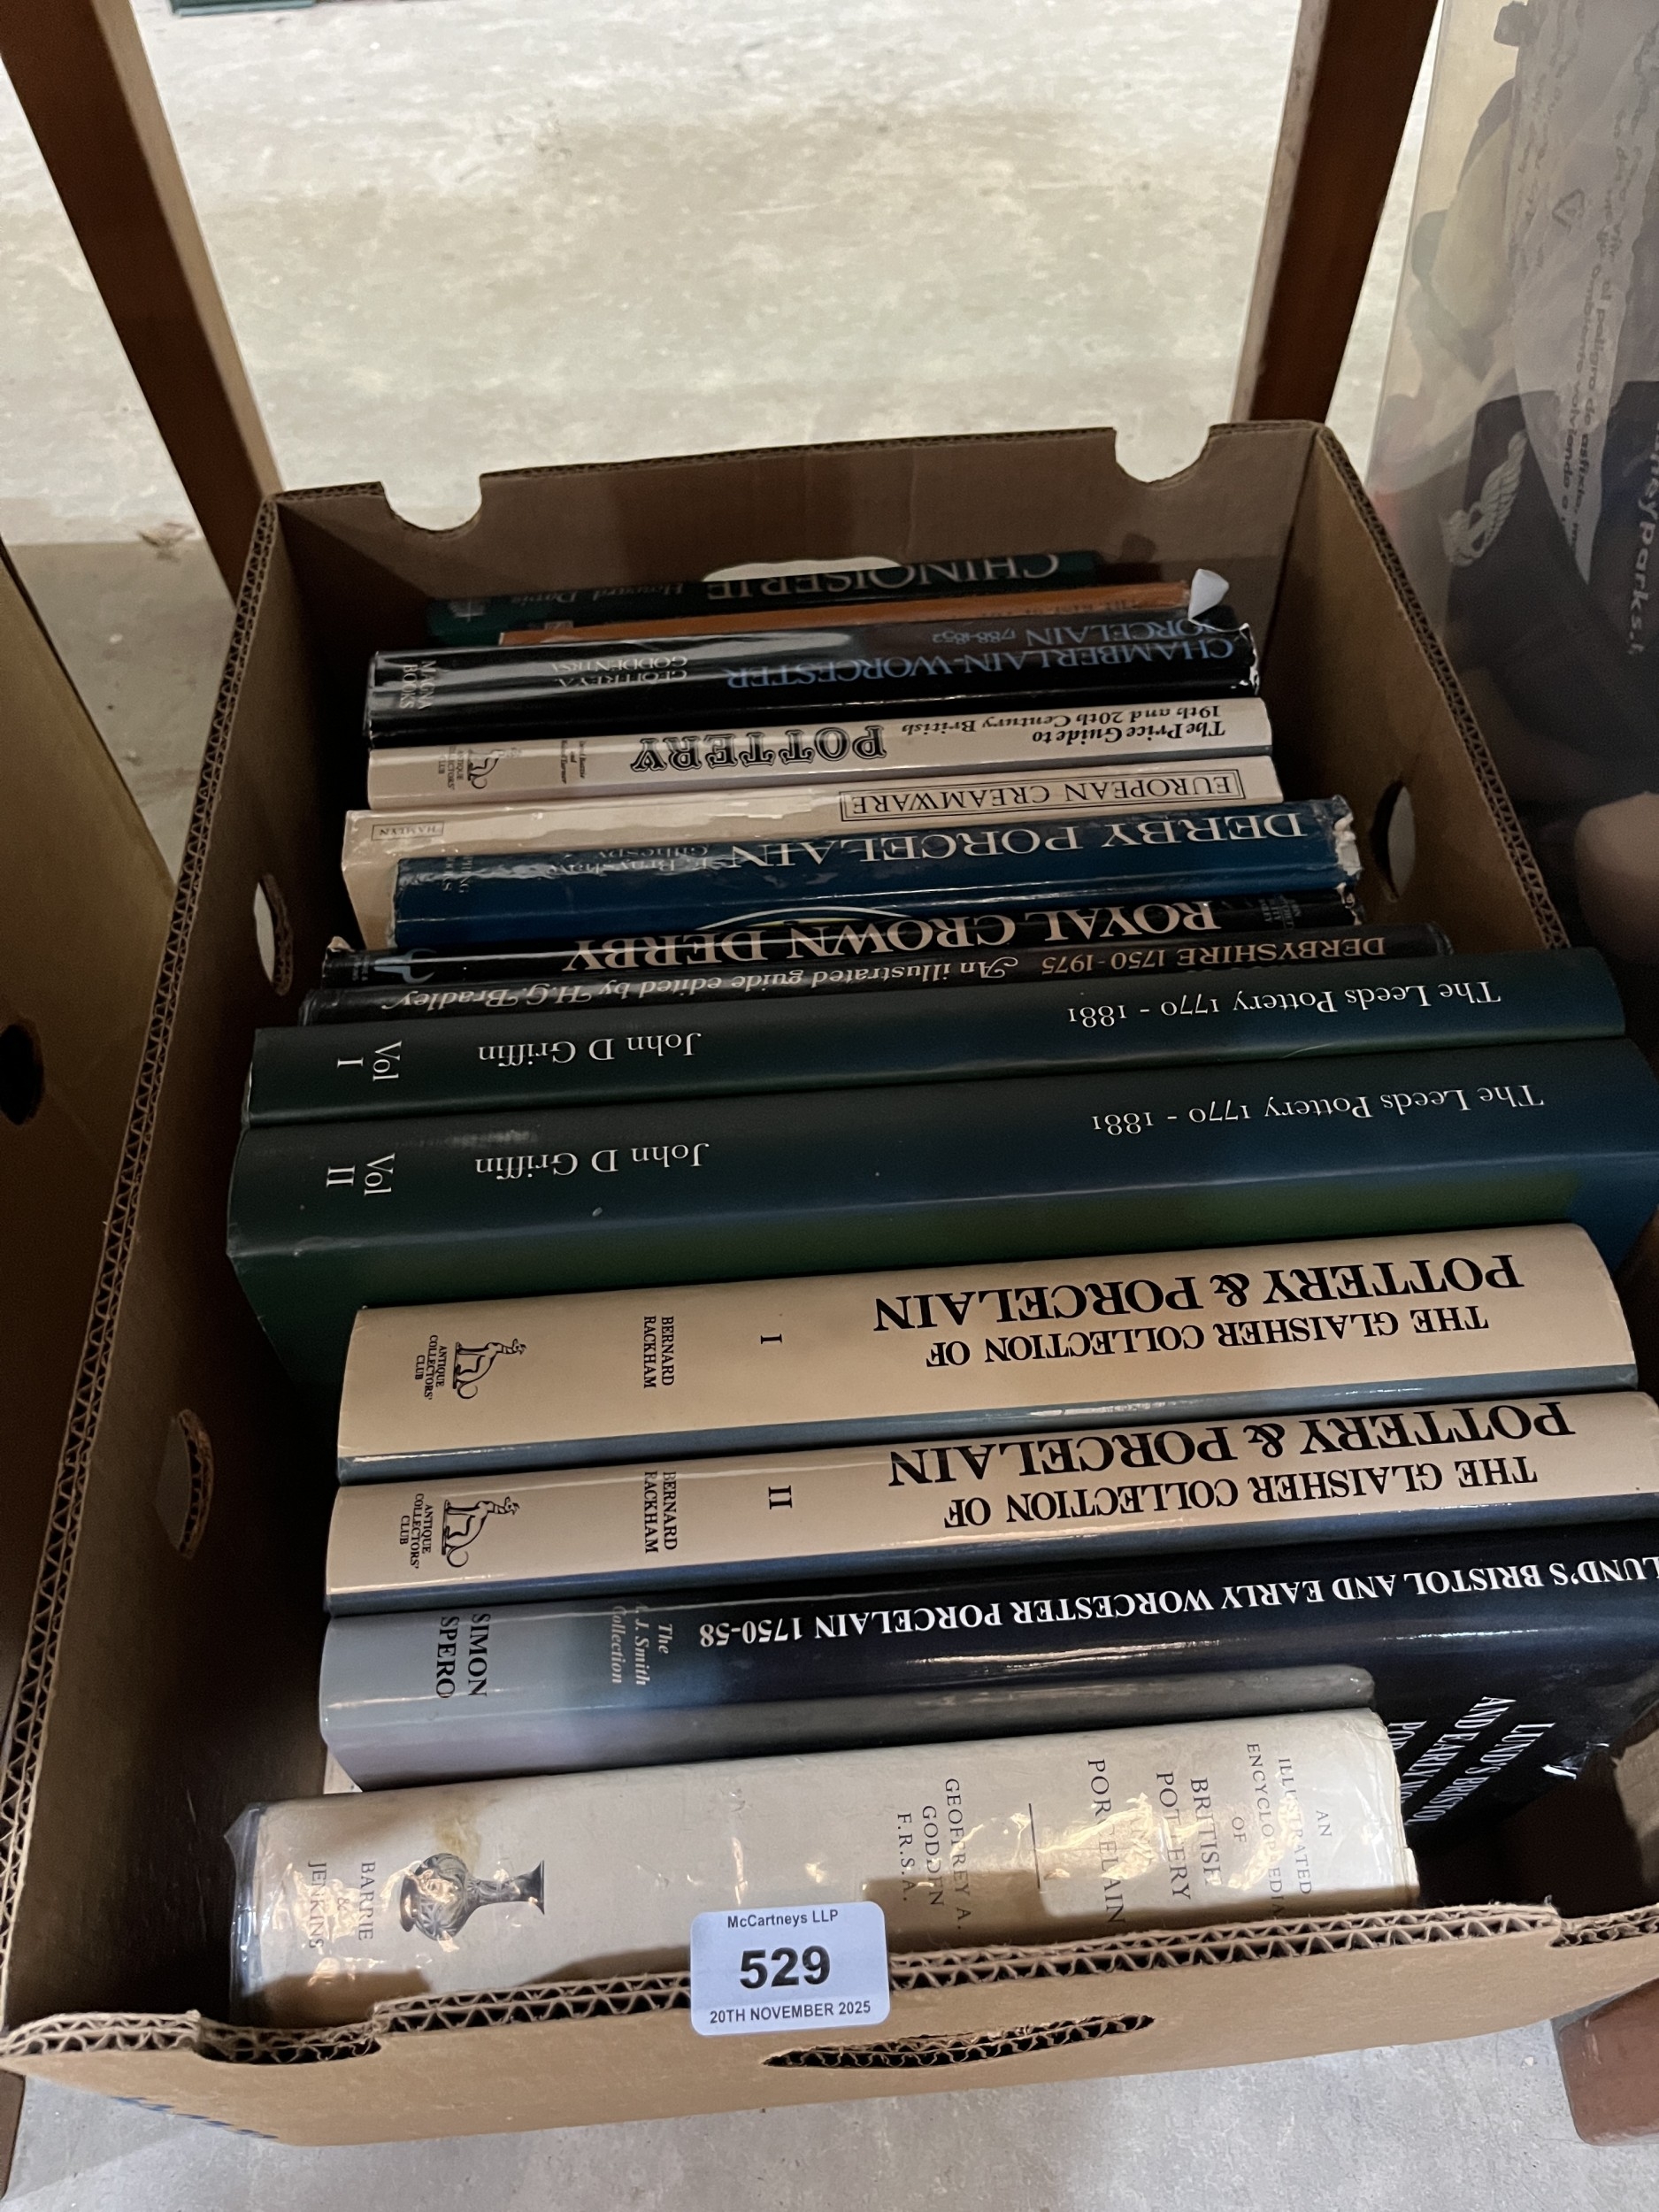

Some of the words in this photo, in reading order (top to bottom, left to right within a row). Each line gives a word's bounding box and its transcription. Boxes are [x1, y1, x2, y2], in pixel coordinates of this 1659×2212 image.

[932, 627, 1016, 645] 1788-1852
[1025, 618, 1207, 647] ORCELAIN
[726, 638, 1233, 688] CHAMBERLAIN-WORCESTER
[901, 720, 977, 736] British
[982, 714, 1071, 730] Century
[1077, 711, 1125, 726] 20th
[1131, 709, 1171, 724] and
[1177, 705, 1220, 721] 19th
[1032, 731, 1053, 745] to
[1056, 726, 1123, 746] Guide
[1126, 723, 1183, 741] Price
[1187, 721, 1225, 738] The
[630, 726, 887, 772] POTTERY
[850, 784, 1049, 814] CREAMWARE
[1063, 775, 1232, 802] EUROPEAN
[1101, 812, 1307, 848] DERBY
[724, 825, 1083, 869] PORCELAIN
[1025, 901, 1221, 941] ROYAL
[562, 930, 768, 972] DERBY
[786, 915, 1017, 959] CROWN
[1177, 937, 1386, 966] DERBYSHIRE
[730, 970, 805, 994] guide
[810, 963, 952, 988] illustrated
[960, 956, 1019, 979] An
[380, 989, 519, 1011] Bradley
[598, 979, 632, 1002] by
[637, 977, 723, 1000] edited
[1232, 990, 1339, 1014] Pottery
[1345, 984, 1432, 1010] Leeds
[1438, 981, 1502, 1005] The
[1065, 1004, 1127, 1029] 1881
[1160, 994, 1220, 1017] 1770
[477, 1040, 577, 1067] Griffin
[588, 1037, 615, 1062] D
[626, 1033, 703, 1057] John
[337, 1056, 364, 1068] I
[373, 1040, 403, 1082] Vol
[1188, 1099, 1251, 1124] 1770
[1263, 1094, 1374, 1119] Pottery
[1379, 1089, 1471, 1116] Leeds
[1477, 1085, 1544, 1109] The
[1092, 1110, 1154, 1136] 1881
[474, 1151, 578, 1180] Griffin
[591, 1148, 619, 1173] D
[630, 1141, 710, 1168] John
[326, 1165, 355, 1188] II
[364, 1152, 396, 1197] Vol
[1209, 1270, 1250, 1309] &
[1261, 1254, 1523, 1306] POTTERY
[872, 1274, 1199, 1333] PORCELAIN
[1212, 1310, 1399, 1348] GLAISHER
[1409, 1305, 1489, 1335] THE
[643, 1315, 657, 1389] RACKHAM
[661, 1316, 674, 1386] BERNARD
[760, 1333, 782, 1344] I
[925, 1338, 971, 1368] OF
[983, 1323, 1205, 1363] COLLECTION
[414, 1354, 426, 1380] CLUB
[424, 1334, 439, 1400] COLLECTORS'
[434, 1345, 448, 1388] ANTIQUE
[1242, 1421, 1287, 1459] &
[1298, 1402, 1575, 1456] POTTERY
[887, 1425, 1233, 1486] PORCELAIN
[1247, 1462, 1443, 1504] GLAISHER
[1453, 1455, 1538, 1488] THE
[644, 1470, 658, 1555] RACKHAM
[662, 1471, 678, 1551] BERNARD
[768, 1485, 793, 1511] II
[943, 1497, 992, 1529] OF
[1004, 1477, 1240, 1522] COLLECTION
[399, 1515, 411, 1546] CLUB
[410, 1493, 425, 1569] COLLECTORS'
[421, 1504, 434, 1555] ANTIQUE
[1330, 1572, 1397, 1602] AND
[1403, 1564, 1543, 1595] BRISTOL
[1548, 1556, 1659, 1588] LUND'S
[1010, 1589, 1215, 1624] WORCESTER
[1220, 1580, 1325, 1610] EARLY
[699, 1617, 804, 1647] 1750-58
[813, 1602, 1003, 1640] PORCELAIN
[611, 1605, 626, 1684] Collection
[657, 1624, 672, 1655] The
[435, 1616, 460, 1700] SPERO
[467, 1613, 491, 1698] SIMON
[634, 1636, 651, 1686] Smith
[1454, 1696, 1517, 1730] AND
[1402, 1732, 1480, 1778] EARLY
[945, 1778, 971, 1896] GEOFFREY
[1189, 1777, 1222, 1886] BRITISH
[1231, 1816, 1247, 1842] OF
[1278, 1757, 1312, 1894] ILLUSTRATED
[1315, 1809, 1333, 1838] AN
[922, 1805, 945, 1906] GODDEN
[307, 1860, 327, 1949] JENKINS
[358, 1861, 376, 1941] BARRIE
[727, 1913, 808, 1929] McCartneys
[811, 1909, 839, 1923] LLP
[956, 1907, 972, 1931] A.
[739, 1945, 831, 1989] 529
[710, 2008, 746, 2024] 20TH
[750, 2002, 834, 2021] NOVEMBER
[838, 2000, 872, 2015] 2025
